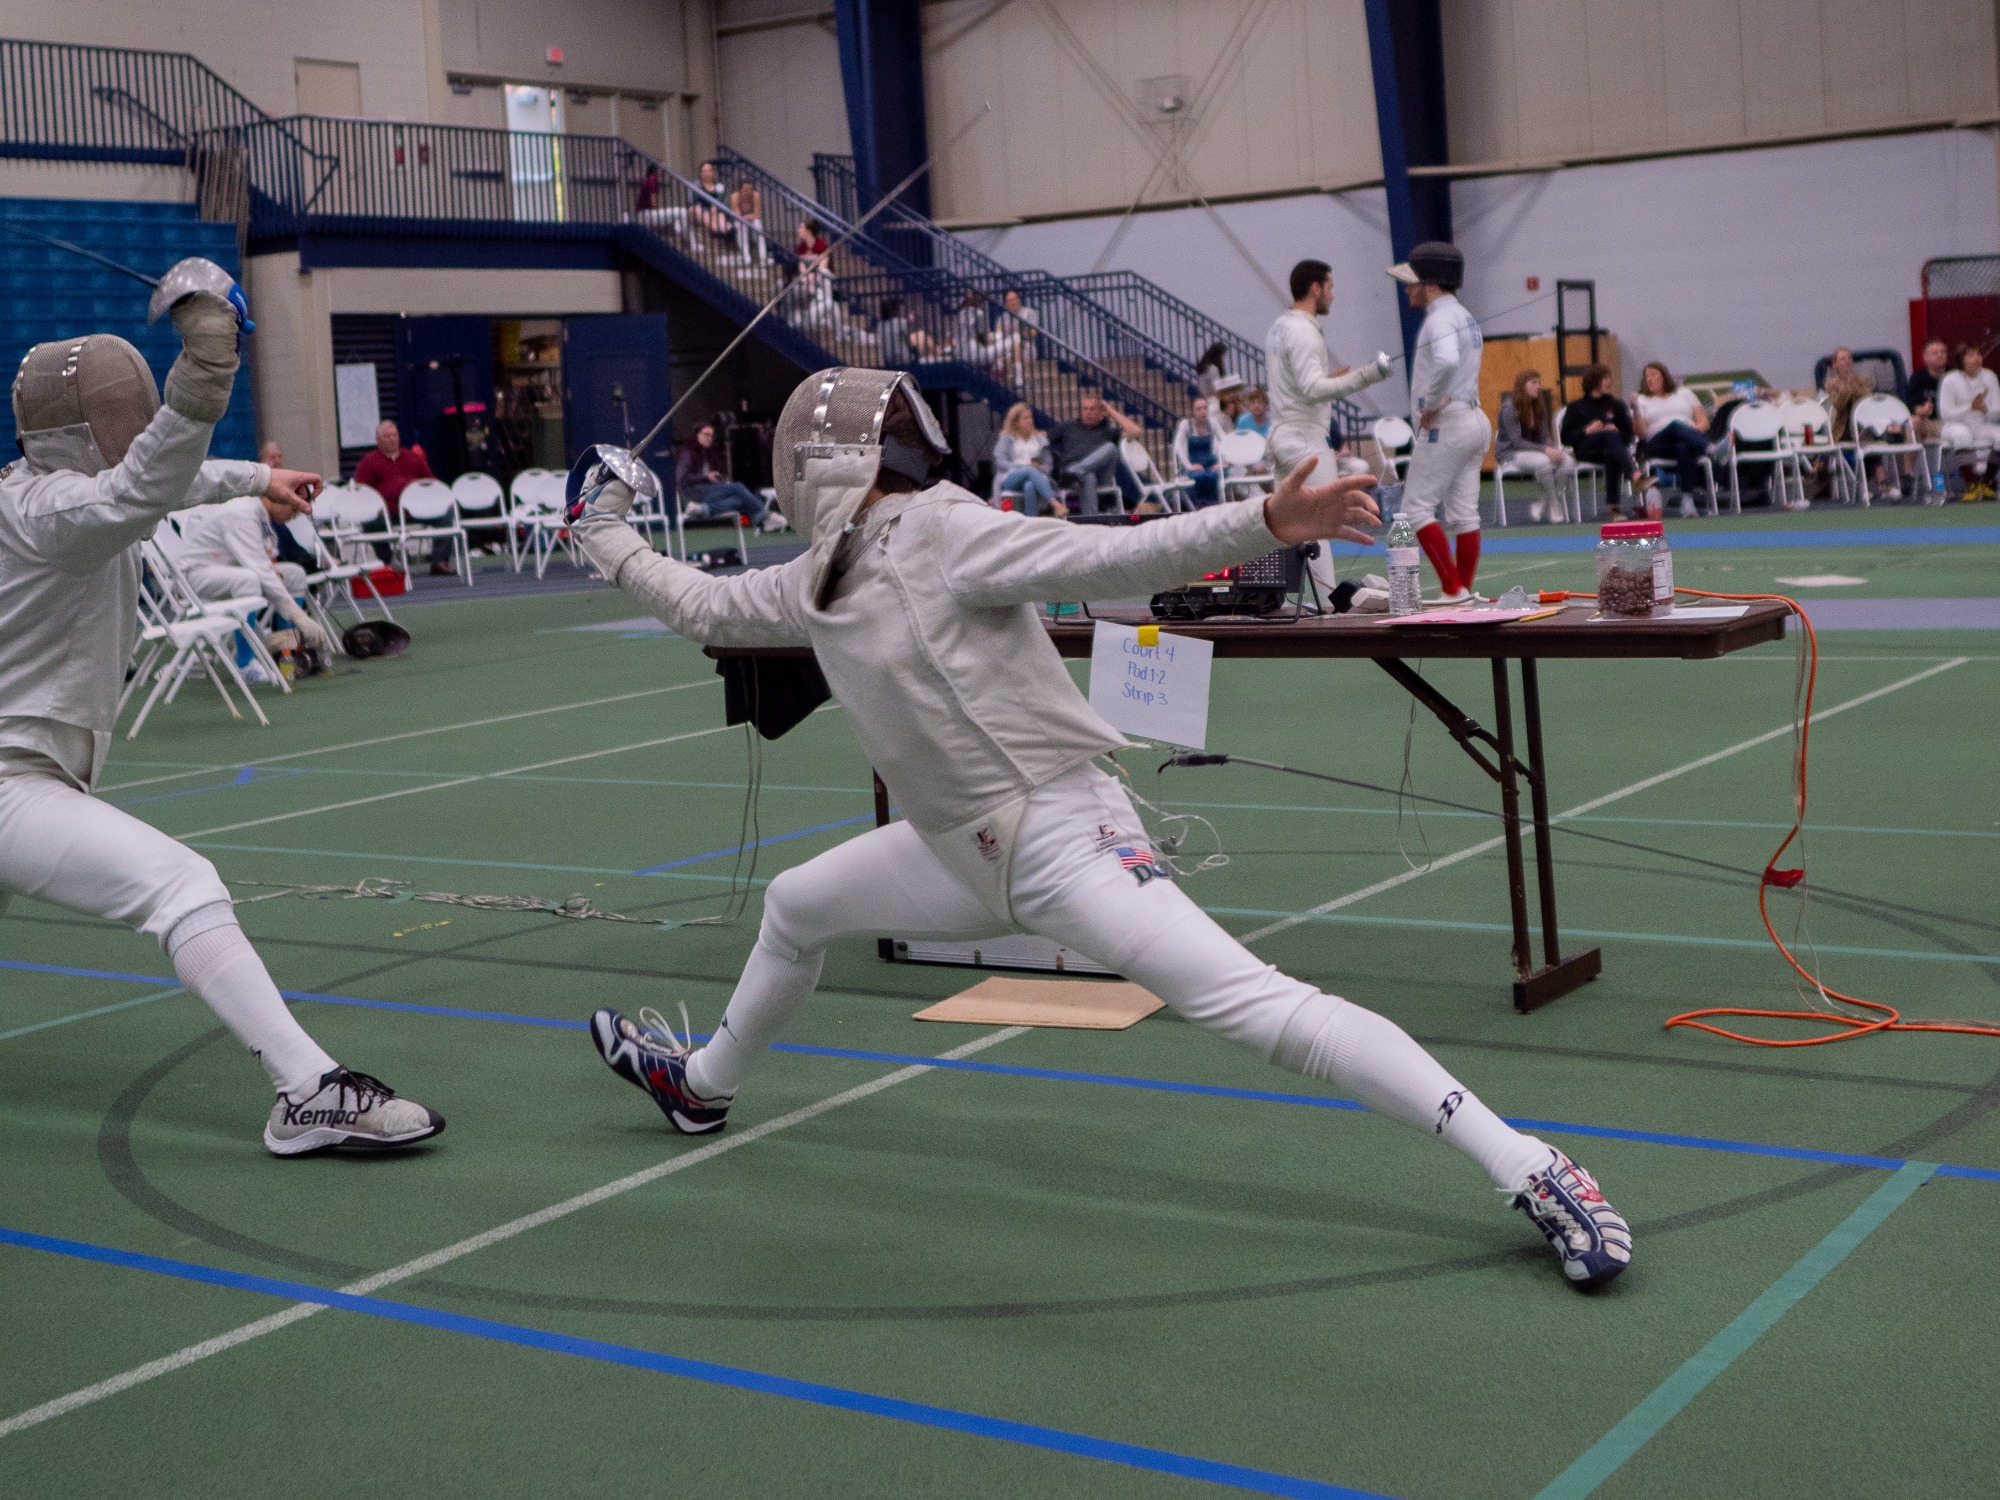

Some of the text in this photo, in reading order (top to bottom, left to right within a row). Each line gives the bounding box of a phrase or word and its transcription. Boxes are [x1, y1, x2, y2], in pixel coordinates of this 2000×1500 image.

[1123, 637, 1175, 662] Court 4
[1128, 661, 1148, 680] Pod
[1121, 682, 1168, 705] Strip 3
[283, 1105, 359, 1128] Kempa
